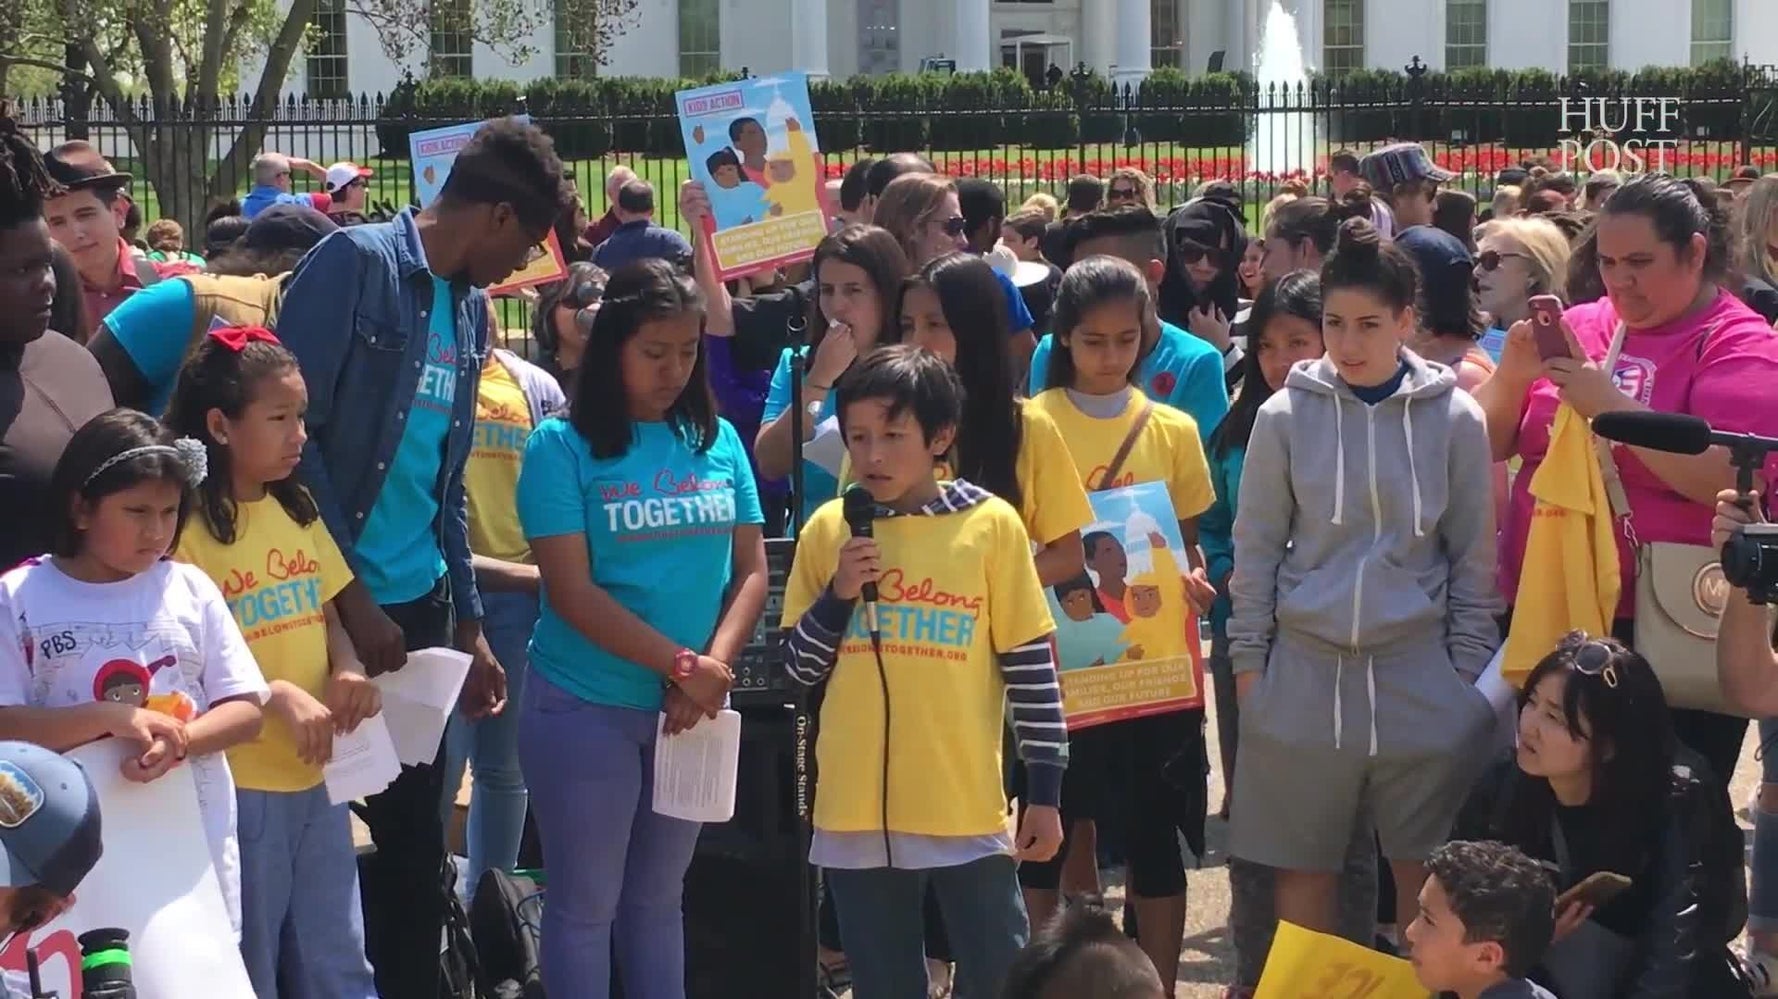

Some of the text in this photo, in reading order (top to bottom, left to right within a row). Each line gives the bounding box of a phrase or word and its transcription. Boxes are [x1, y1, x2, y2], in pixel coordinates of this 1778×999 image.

[600, 481, 641, 501] We
[877, 567, 985, 621] Belong
[40, 630, 77, 660] PBS
